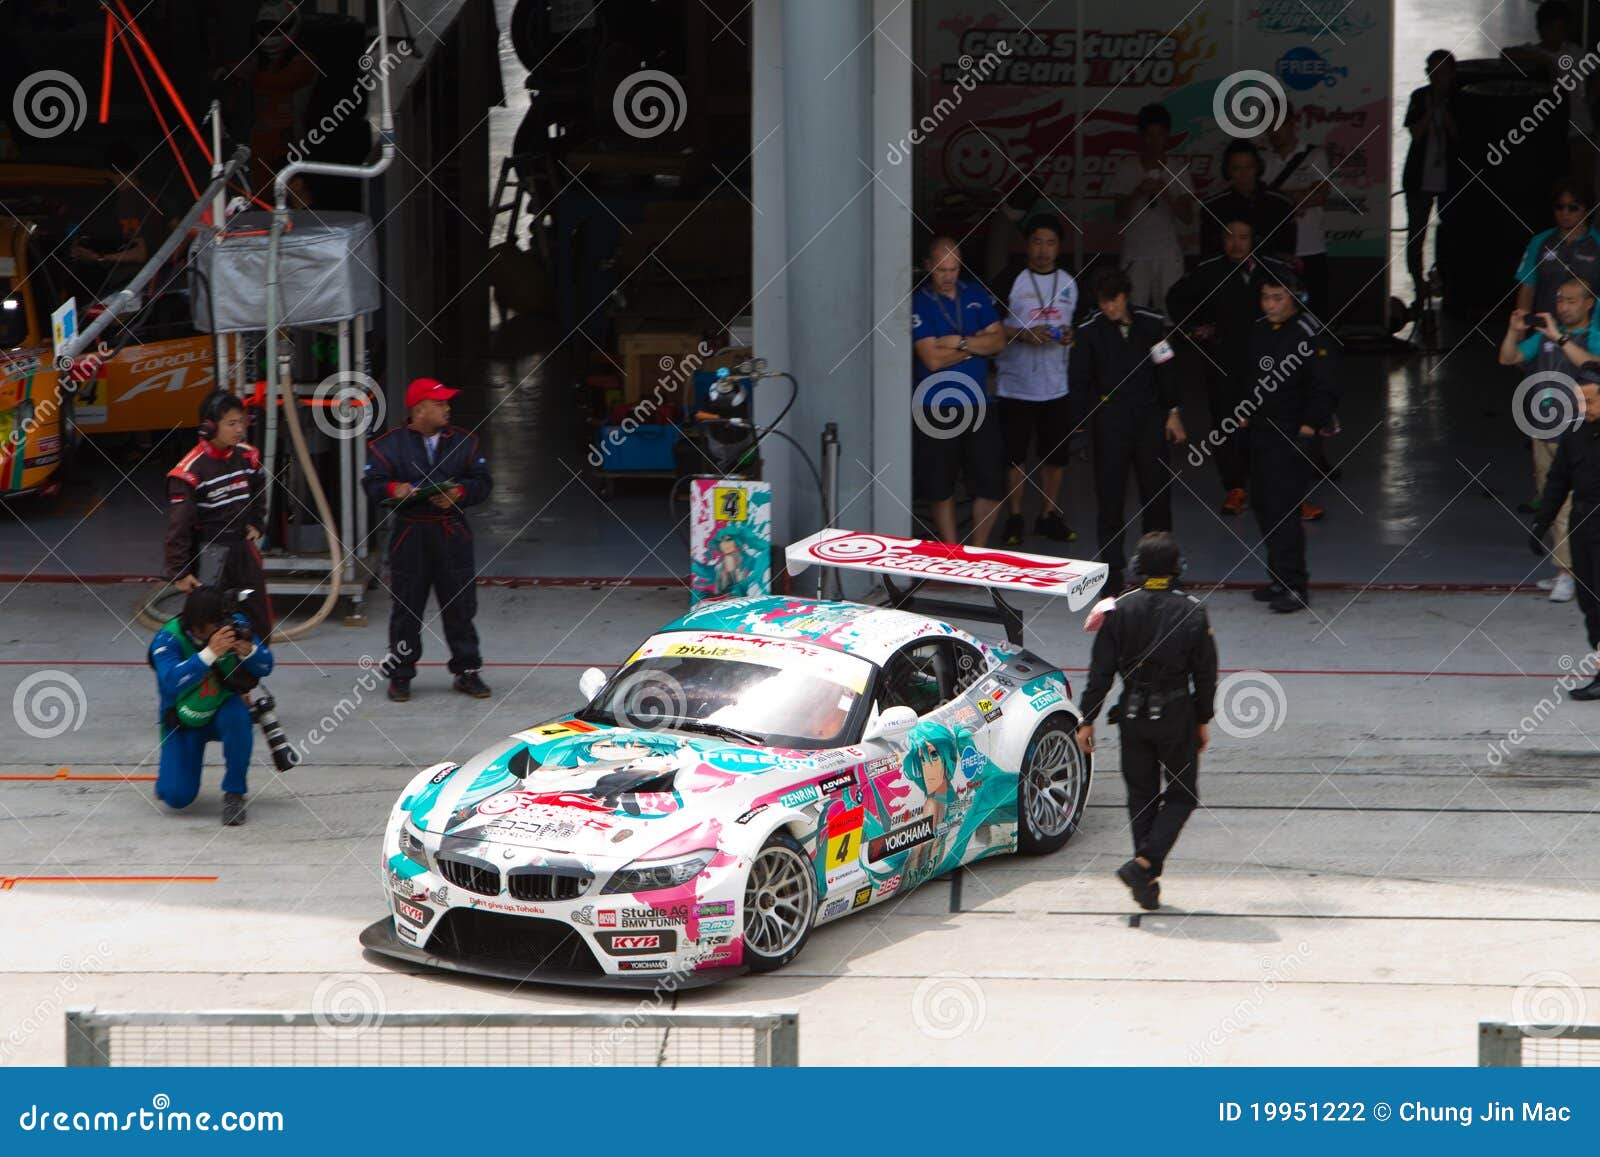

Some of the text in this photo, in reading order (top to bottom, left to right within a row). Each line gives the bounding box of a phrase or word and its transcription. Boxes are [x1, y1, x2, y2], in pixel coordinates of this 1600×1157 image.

[721, 491, 740, 518] 4
[872, 557, 1022, 582] RACING
[822, 775, 852, 791] ADVAN
[781, 785, 817, 807] ZENRIN
[885, 821, 932, 852] YOKOHAMA
[835, 832, 851, 863] 4
[517, 905, 545, 914] Tohoku
[621, 906, 667, 918] Studie
[669, 905, 689, 916] AG
[621, 919, 647, 929] BMW
[650, 916, 689, 928] TUNING
[613, 936, 659, 948] KYB
[630, 961, 669, 970] YOKOHAMA
